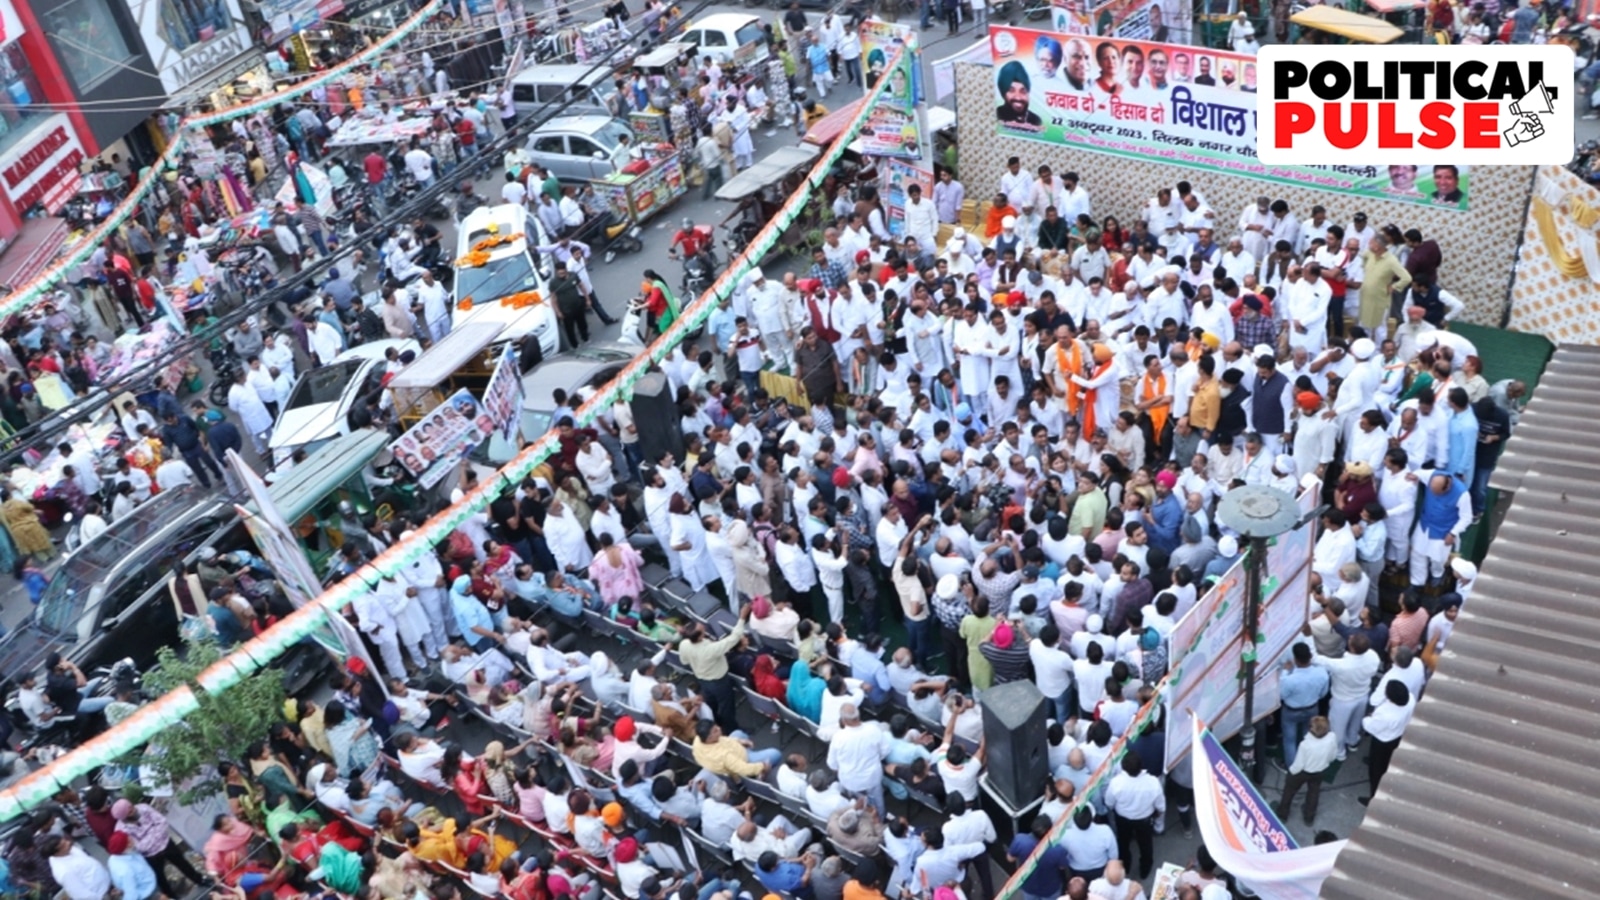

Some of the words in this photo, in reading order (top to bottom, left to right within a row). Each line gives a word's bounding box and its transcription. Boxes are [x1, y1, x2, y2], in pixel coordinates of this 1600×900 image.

[172, 34, 243, 86] MADAAN
[1045, 91, 1078, 112] जवाब
[1082, 92, 1095, 114] दो
[1110, 94, 1147, 121] हिसाब
[1151, 101, 1165, 124] दो
[1170, 86, 1248, 137] विशाल
[1152, 130, 1195, 149] तिलक
[1199, 138, 1232, 153] नगर
